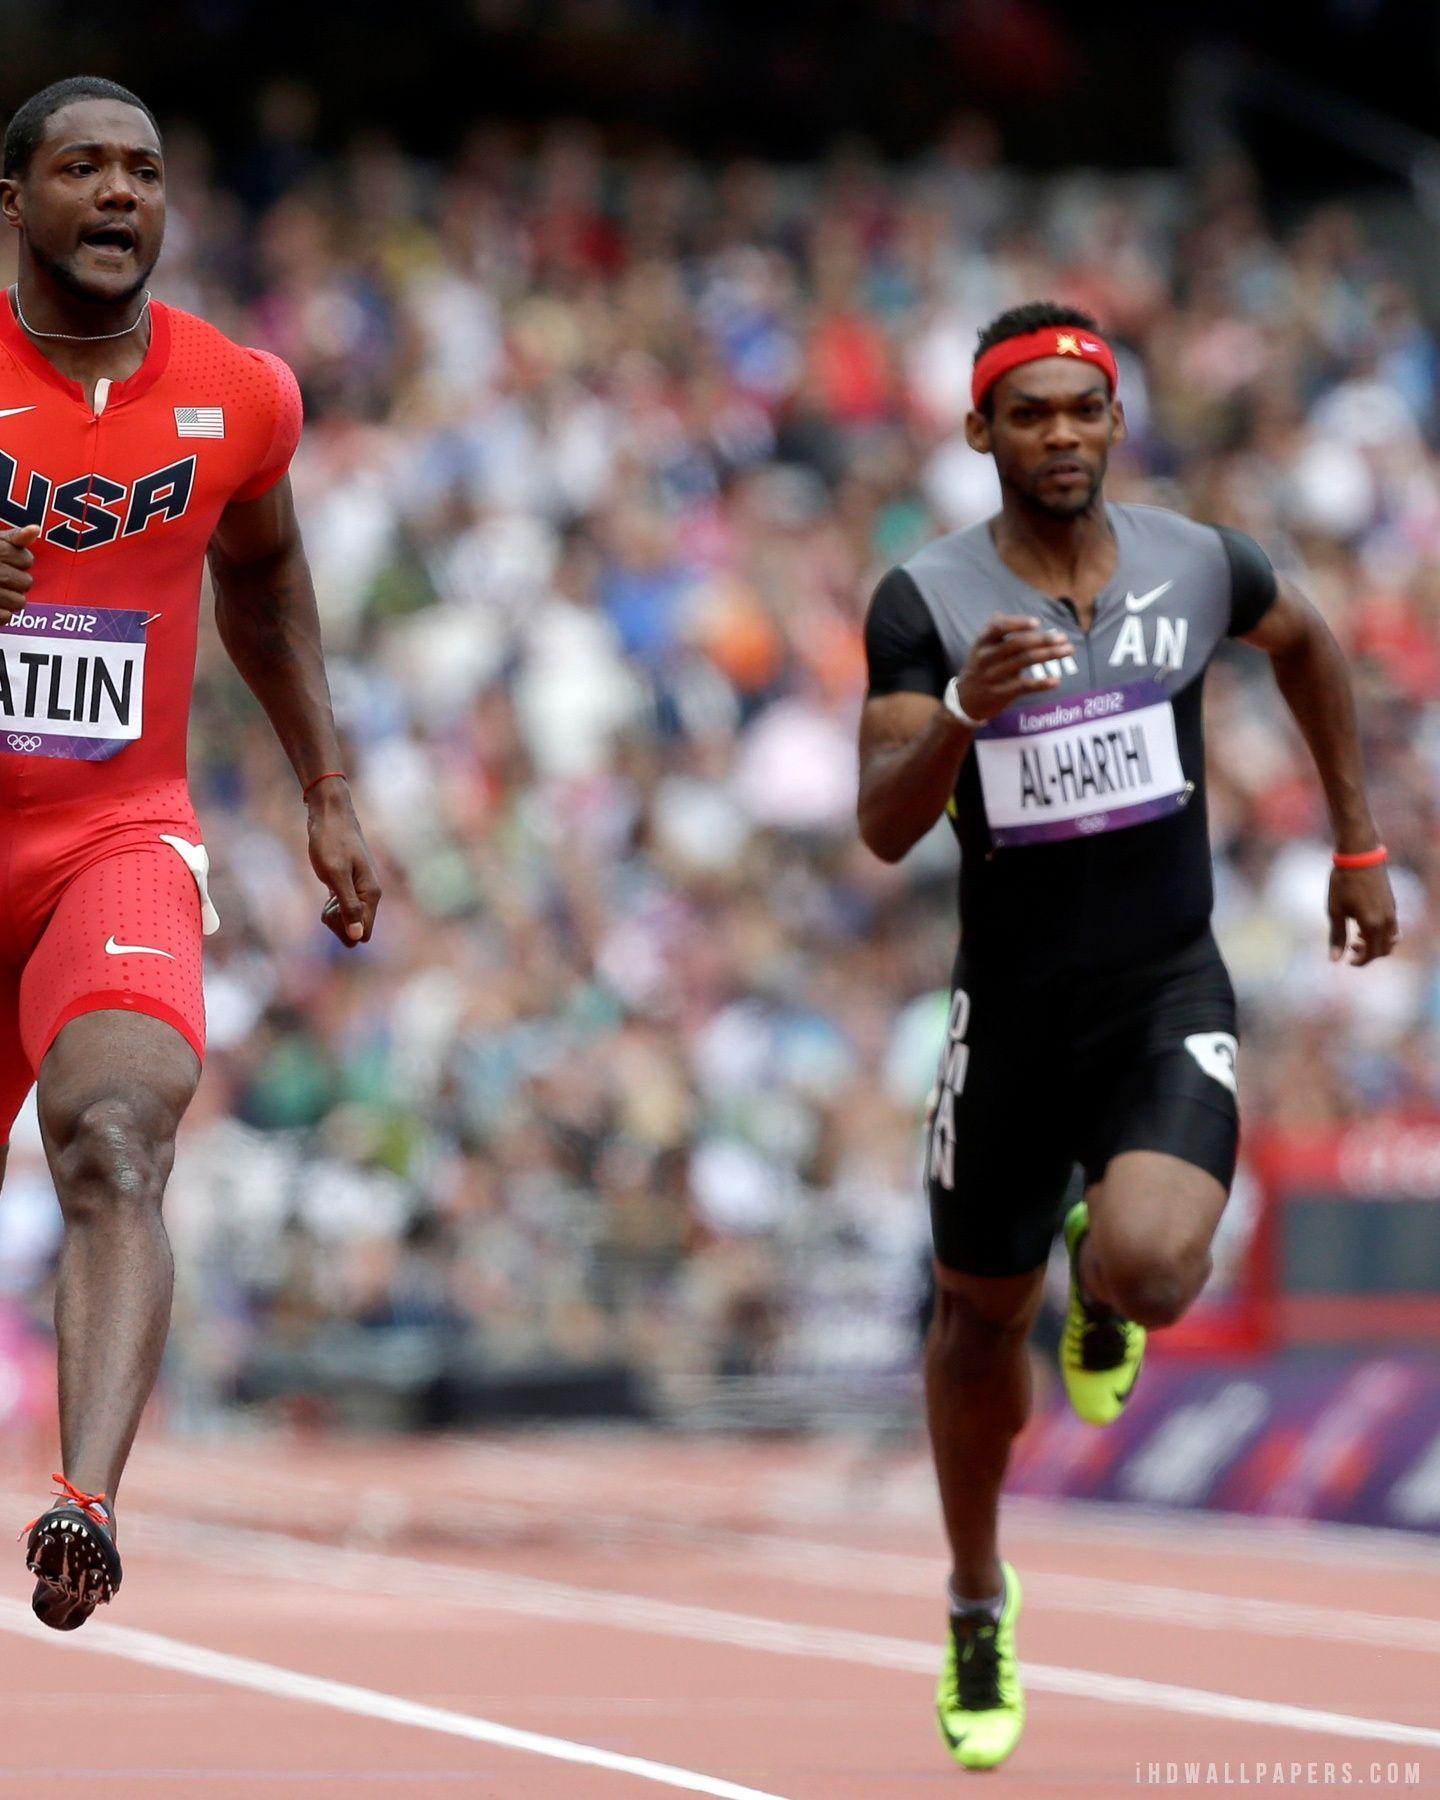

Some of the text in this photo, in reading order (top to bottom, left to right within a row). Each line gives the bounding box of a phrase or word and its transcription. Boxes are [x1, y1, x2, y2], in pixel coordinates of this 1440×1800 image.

[5, 608, 97, 634] don 2012
[1019, 692, 1124, 732] London 2012
[1020, 724, 1152, 808] AL-HARTHI
